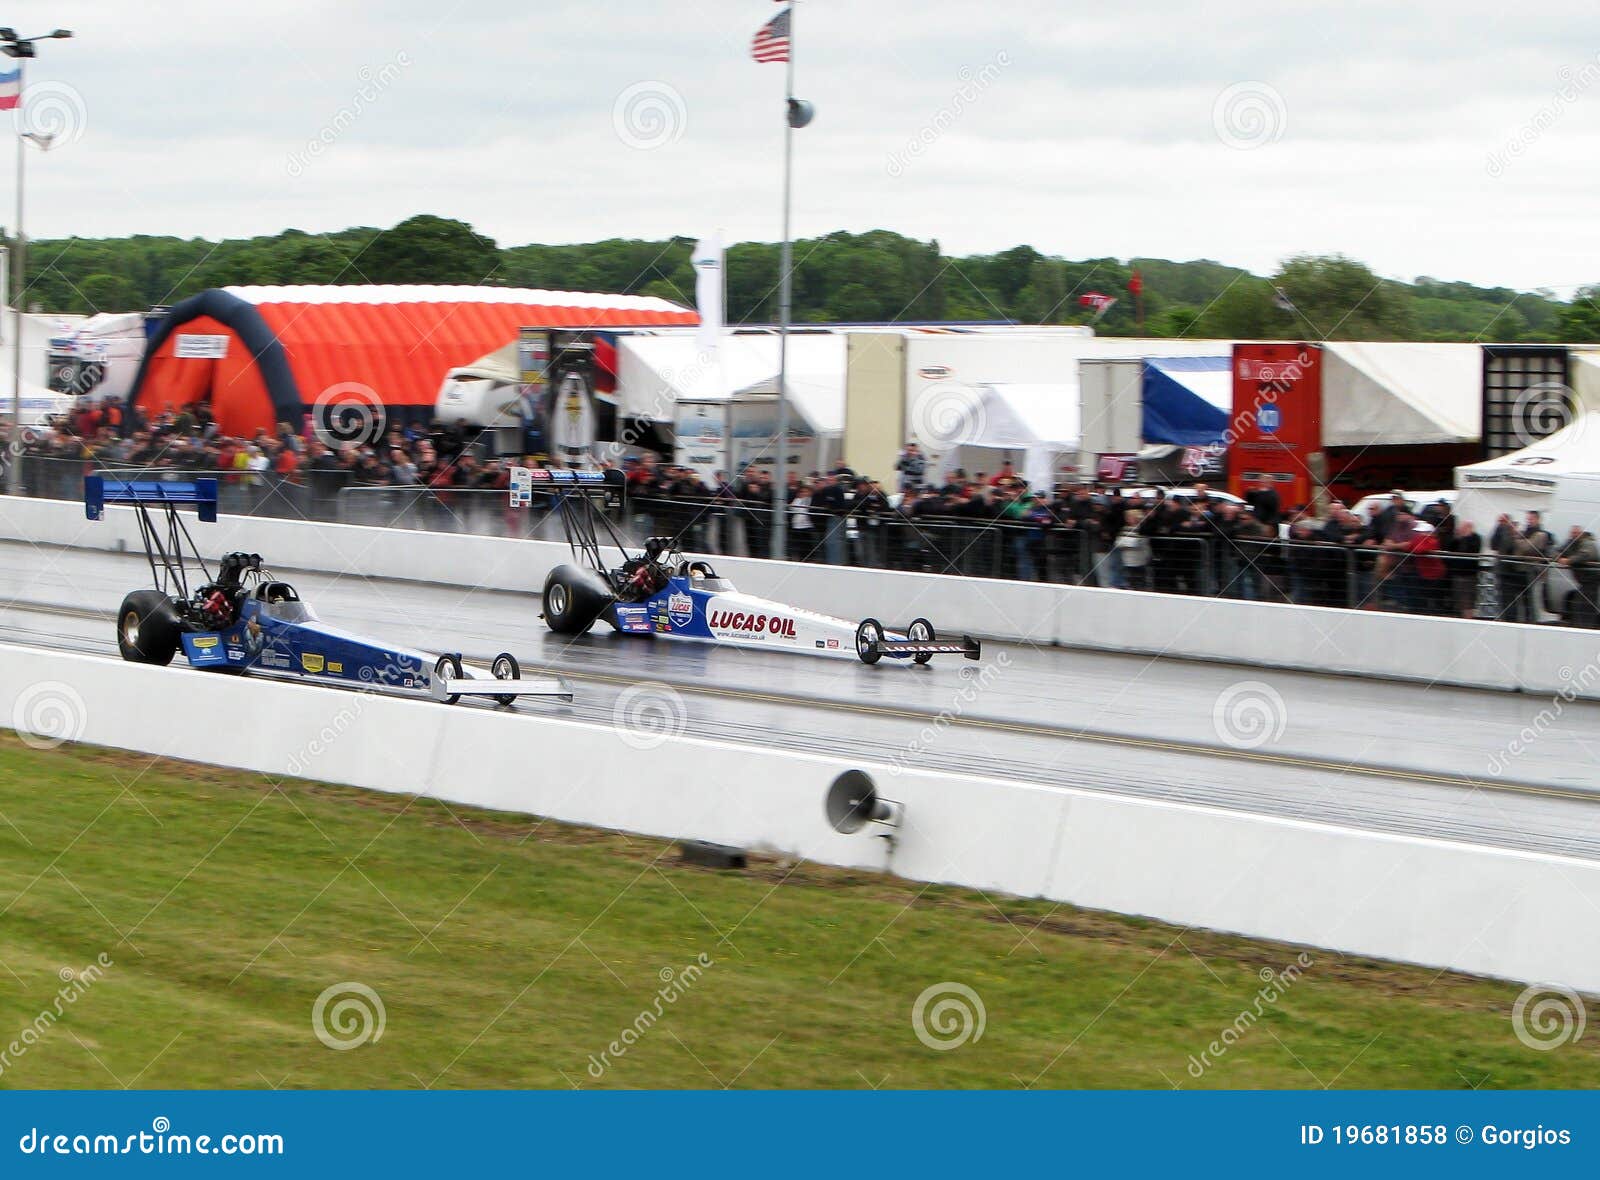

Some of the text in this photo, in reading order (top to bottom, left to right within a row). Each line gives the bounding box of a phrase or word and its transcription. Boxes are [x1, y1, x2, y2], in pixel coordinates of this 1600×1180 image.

[671, 602, 690, 612] LUCAS
[709, 610, 767, 633] LUCAS
[769, 616, 797, 636] OIL
